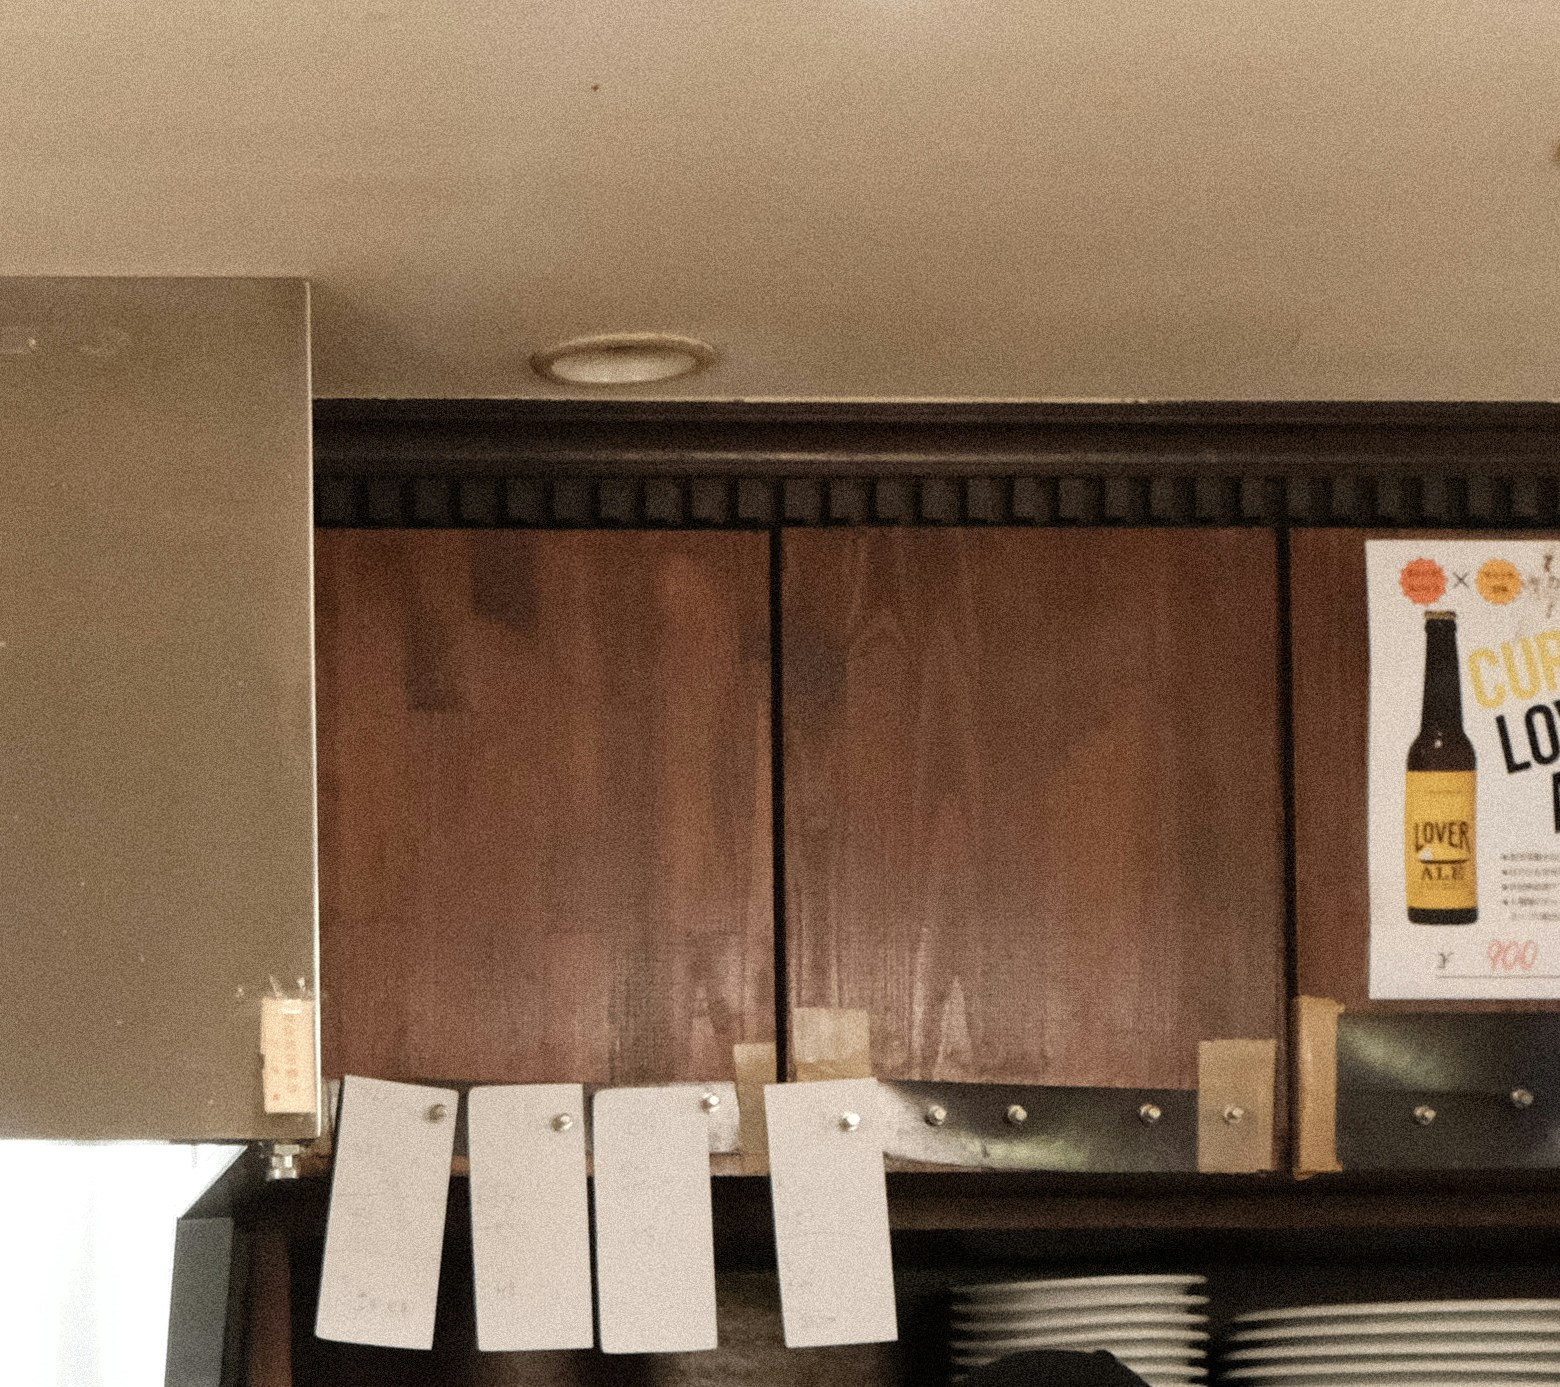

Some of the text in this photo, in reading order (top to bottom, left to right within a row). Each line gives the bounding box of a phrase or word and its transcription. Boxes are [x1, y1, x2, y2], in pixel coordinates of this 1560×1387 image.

[1413, 821, 1471, 852] LOVER
[1421, 865, 1465, 881] ALE
[1488, 940, 1538, 972] 900
